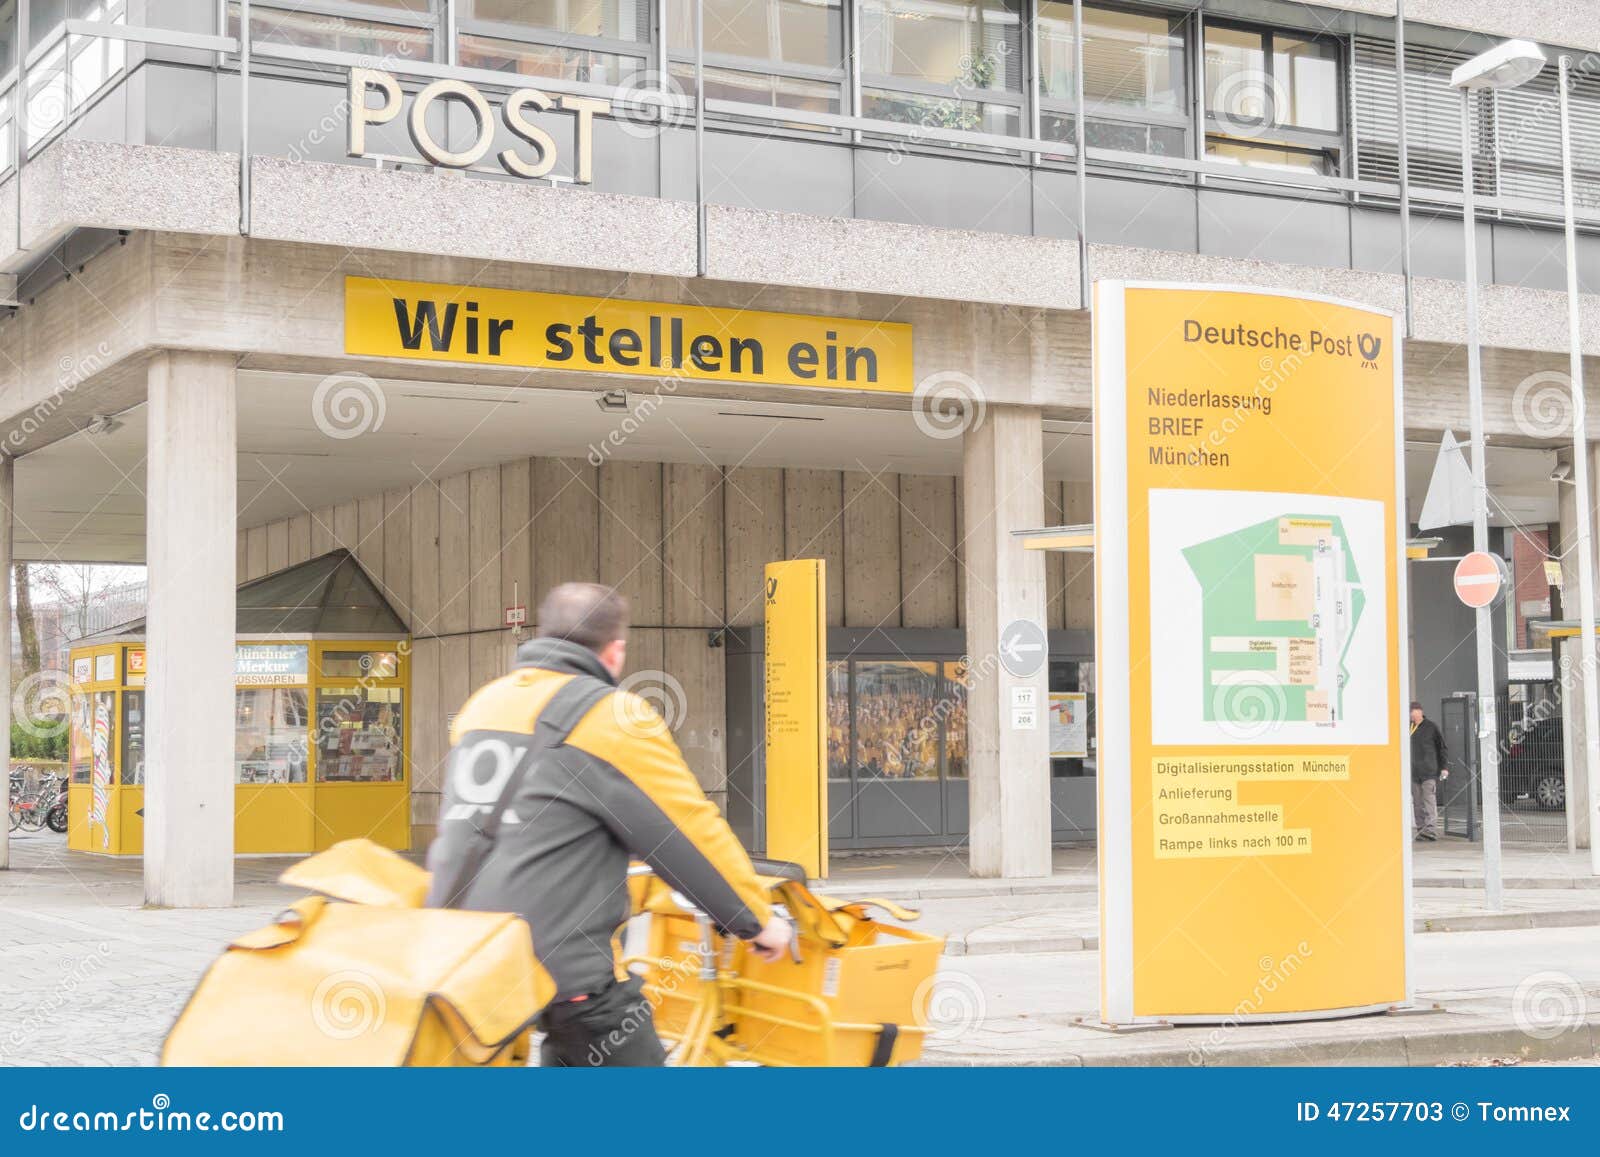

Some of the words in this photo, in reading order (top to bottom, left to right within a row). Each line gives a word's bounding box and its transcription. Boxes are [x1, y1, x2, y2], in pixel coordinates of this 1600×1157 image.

[346, 66, 612, 186] POST
[393, 298, 514, 357] Wir
[545, 315, 765, 374] stellen
[787, 330, 879, 383] ein
[1184, 319, 1301, 350] Deutsche
[1310, 330, 1353, 357] Post
[1147, 387, 1272, 416] Niederlassung
[1149, 417, 1204, 437] BRIEF
[1149, 446, 1230, 467] München
[237, 660, 289, 673] Merkur
[1157, 761, 1295, 776] Digitalisierungsstation
[1302, 760, 1346, 773] München
[1158, 787, 1232, 801] Anlieferung
[1159, 811, 1279, 825] Großannahmestelle
[1159, 838, 1203, 852] Rampe
[1209, 837, 1238, 849] links
[1243, 836, 1271, 847] nach
[1276, 835, 1294, 847] 100
[1298, 836, 1308, 846] m
